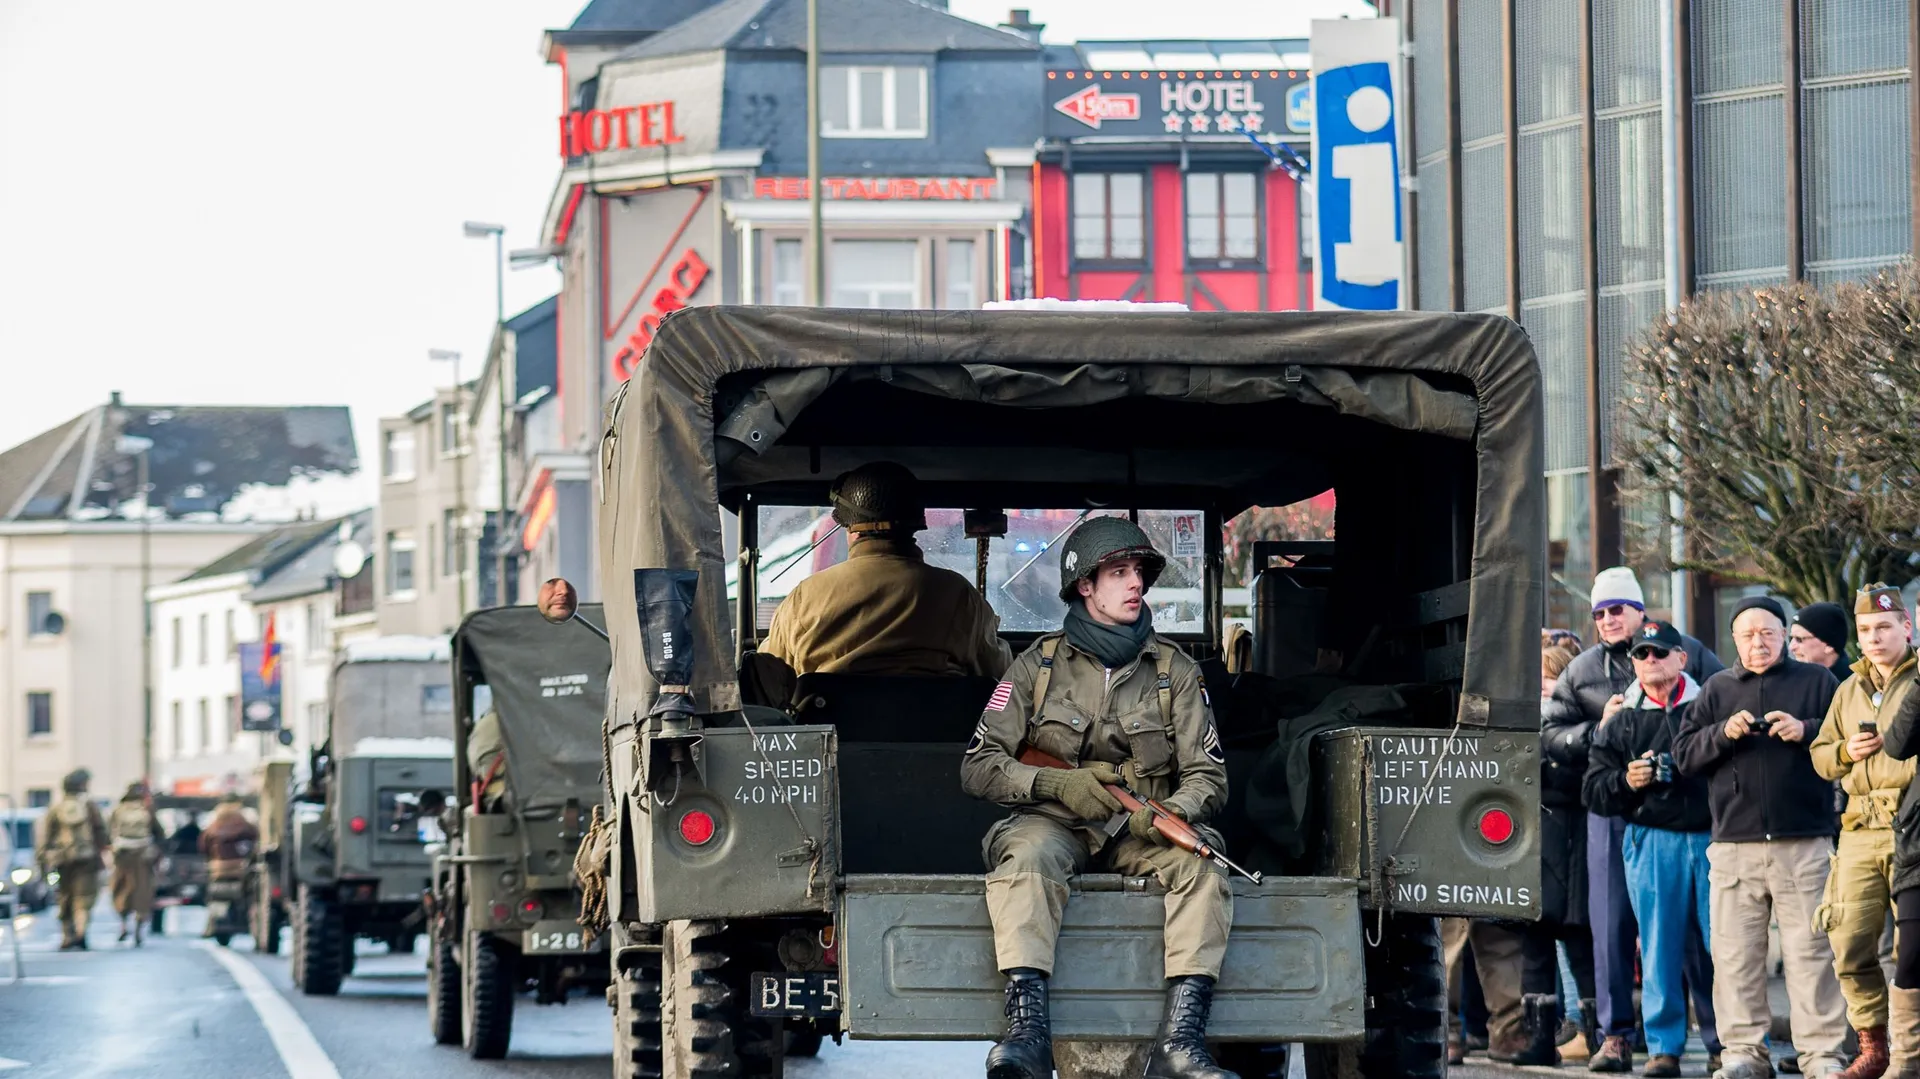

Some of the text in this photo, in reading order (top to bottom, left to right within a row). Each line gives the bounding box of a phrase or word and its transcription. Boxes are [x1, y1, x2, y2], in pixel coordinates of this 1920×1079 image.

[1160, 80, 1264, 112] HOTEL
[558, 99, 686, 158] HOTEL
[752, 732, 798, 752] MAX
[1381, 737, 1479, 756] CAUTION
[744, 759, 821, 780] SPEED
[1438, 760, 1500, 779] HAND
[734, 785, 817, 804] 40 MPH
[1379, 786, 1452, 805] DRIVE
[1398, 883, 1530, 907] NO SIGNALS
[762, 976, 839, 1011] BE-5
